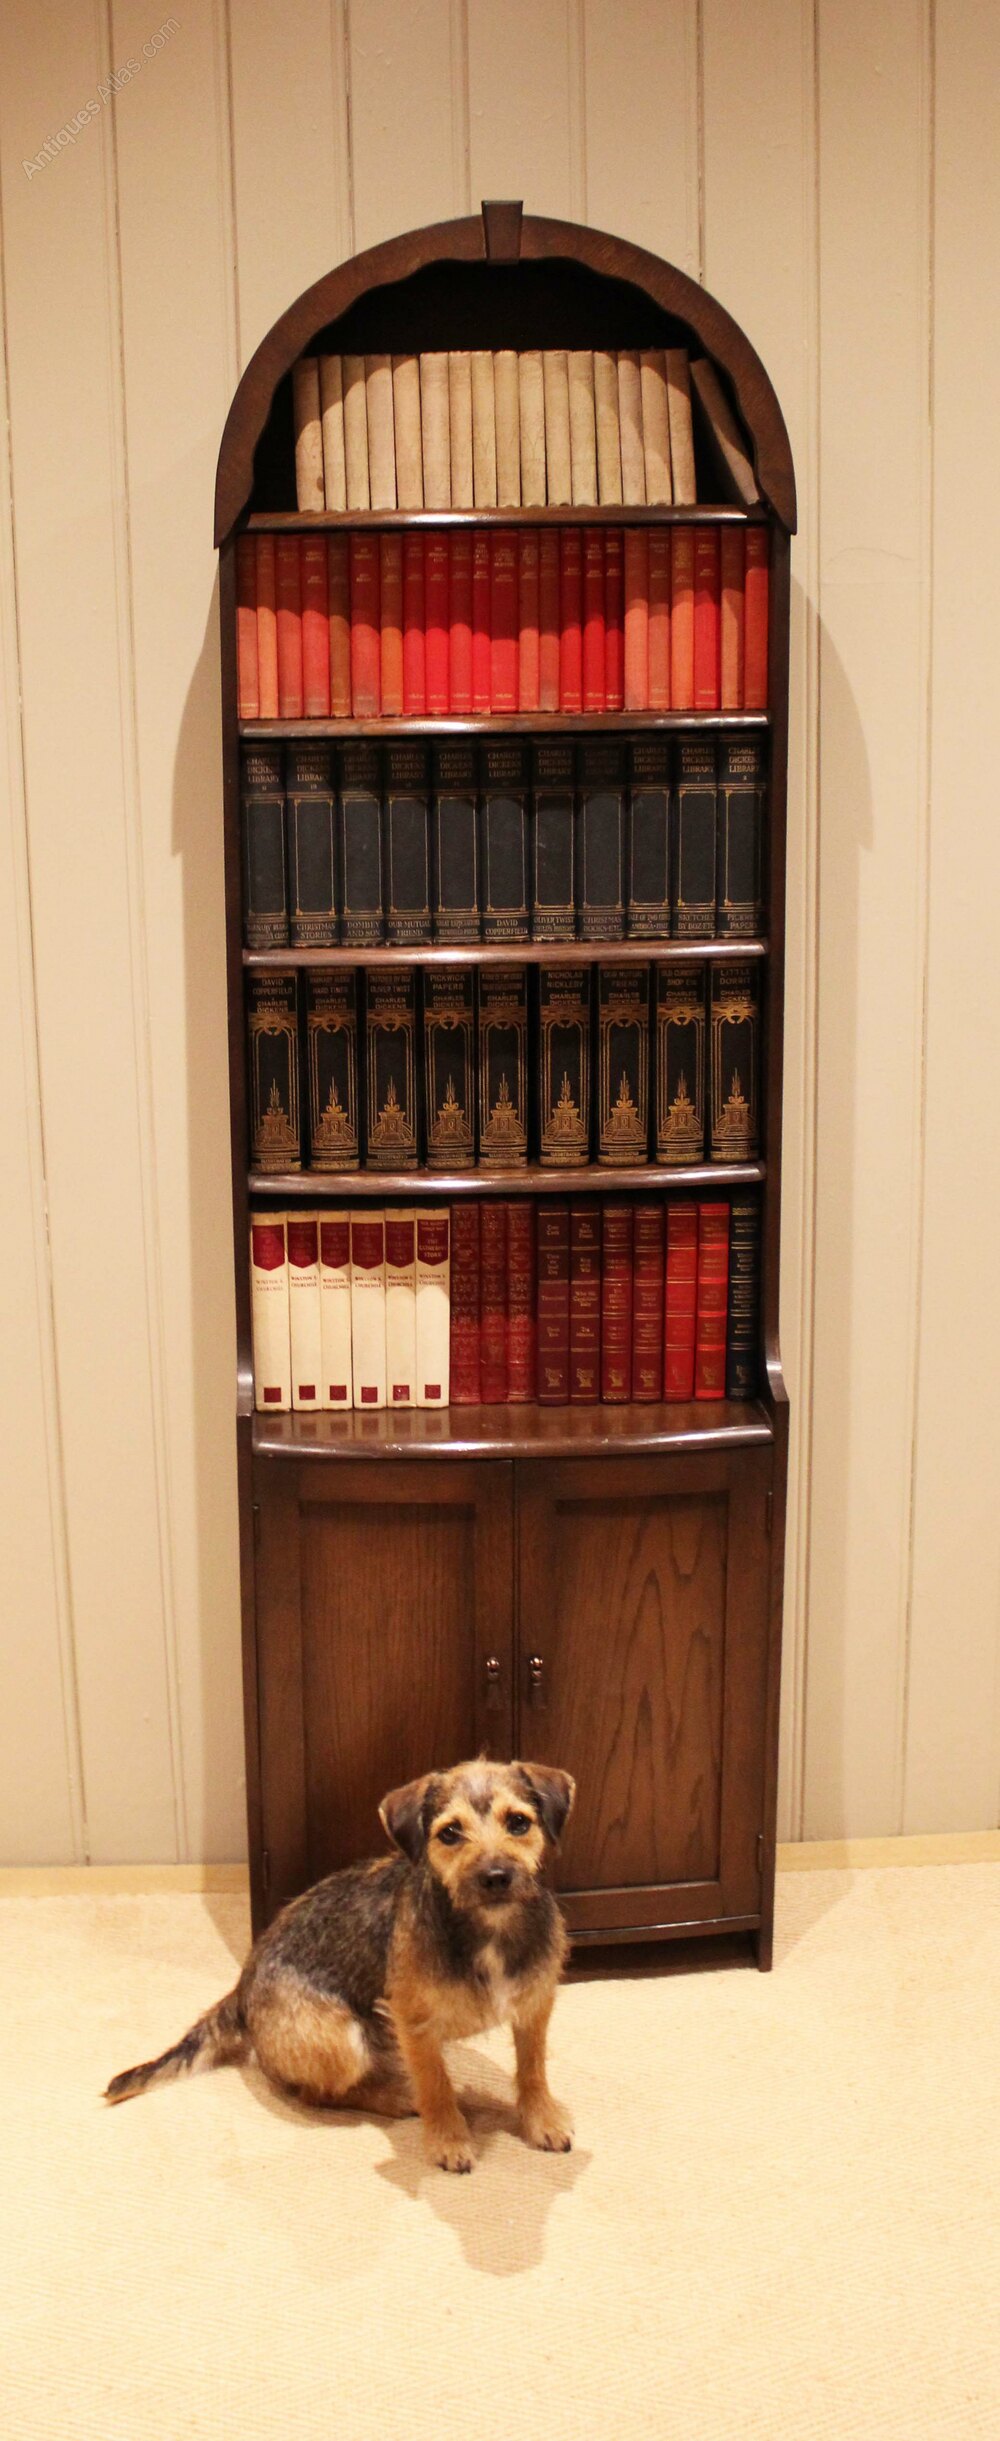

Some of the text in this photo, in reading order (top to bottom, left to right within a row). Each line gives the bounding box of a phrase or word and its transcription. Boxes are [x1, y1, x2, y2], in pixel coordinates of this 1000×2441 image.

[533, 916, 574, 924] OLIVER TWIST
[583, 916, 622, 924] CHRISTMAS
[678, 914, 715, 922] SKETCHES
[296, 922, 336, 931] CHRISTMAS
[347, 921, 380, 929] DOMBEY
[388, 920, 431, 928] OUR MUTUAL
[496, 919, 519, 927] DAVID
[678, 922, 687, 930] BY
[300, 932, 333, 940] STORIES
[347, 929, 381, 937] AND SON
[396, 929, 423, 937] FRIEND
[485, 928, 529, 936] COPPERFIELD
[548, 971, 583, 979] NICHOLAS
[720, 969, 750, 977] LITTLE
[261, 978, 283, 986] DAVID
[430, 974, 465, 982] PICKWICK
[719, 977, 750, 985] DORRIT
[252, 987, 293, 995] COPPERFIELD
[432, 983, 463, 991] PAPERS
